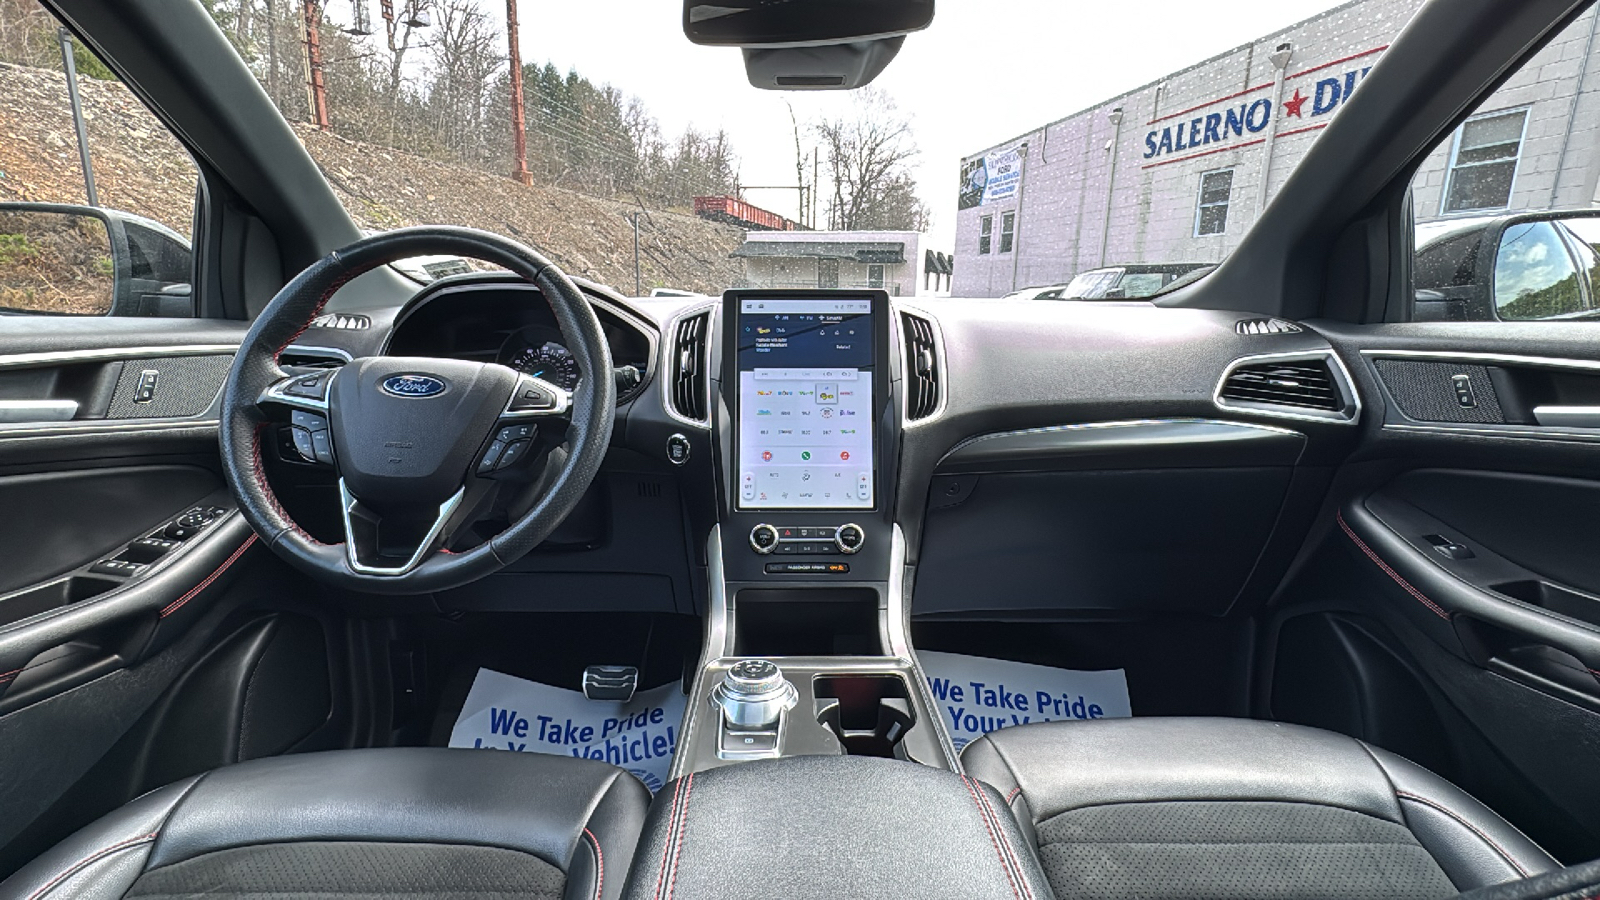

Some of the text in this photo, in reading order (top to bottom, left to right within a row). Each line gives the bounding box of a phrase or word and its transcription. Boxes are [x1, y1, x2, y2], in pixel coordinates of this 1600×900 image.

[1143, 98, 1272, 159] SALERNO
[392, 376, 433, 393] Ford
[926, 677, 1104, 719] We Take Pride
[490, 707, 664, 745] We Take Pride
[947, 706, 1006, 734] Your
[572, 726, 676, 766] Vehicle!
